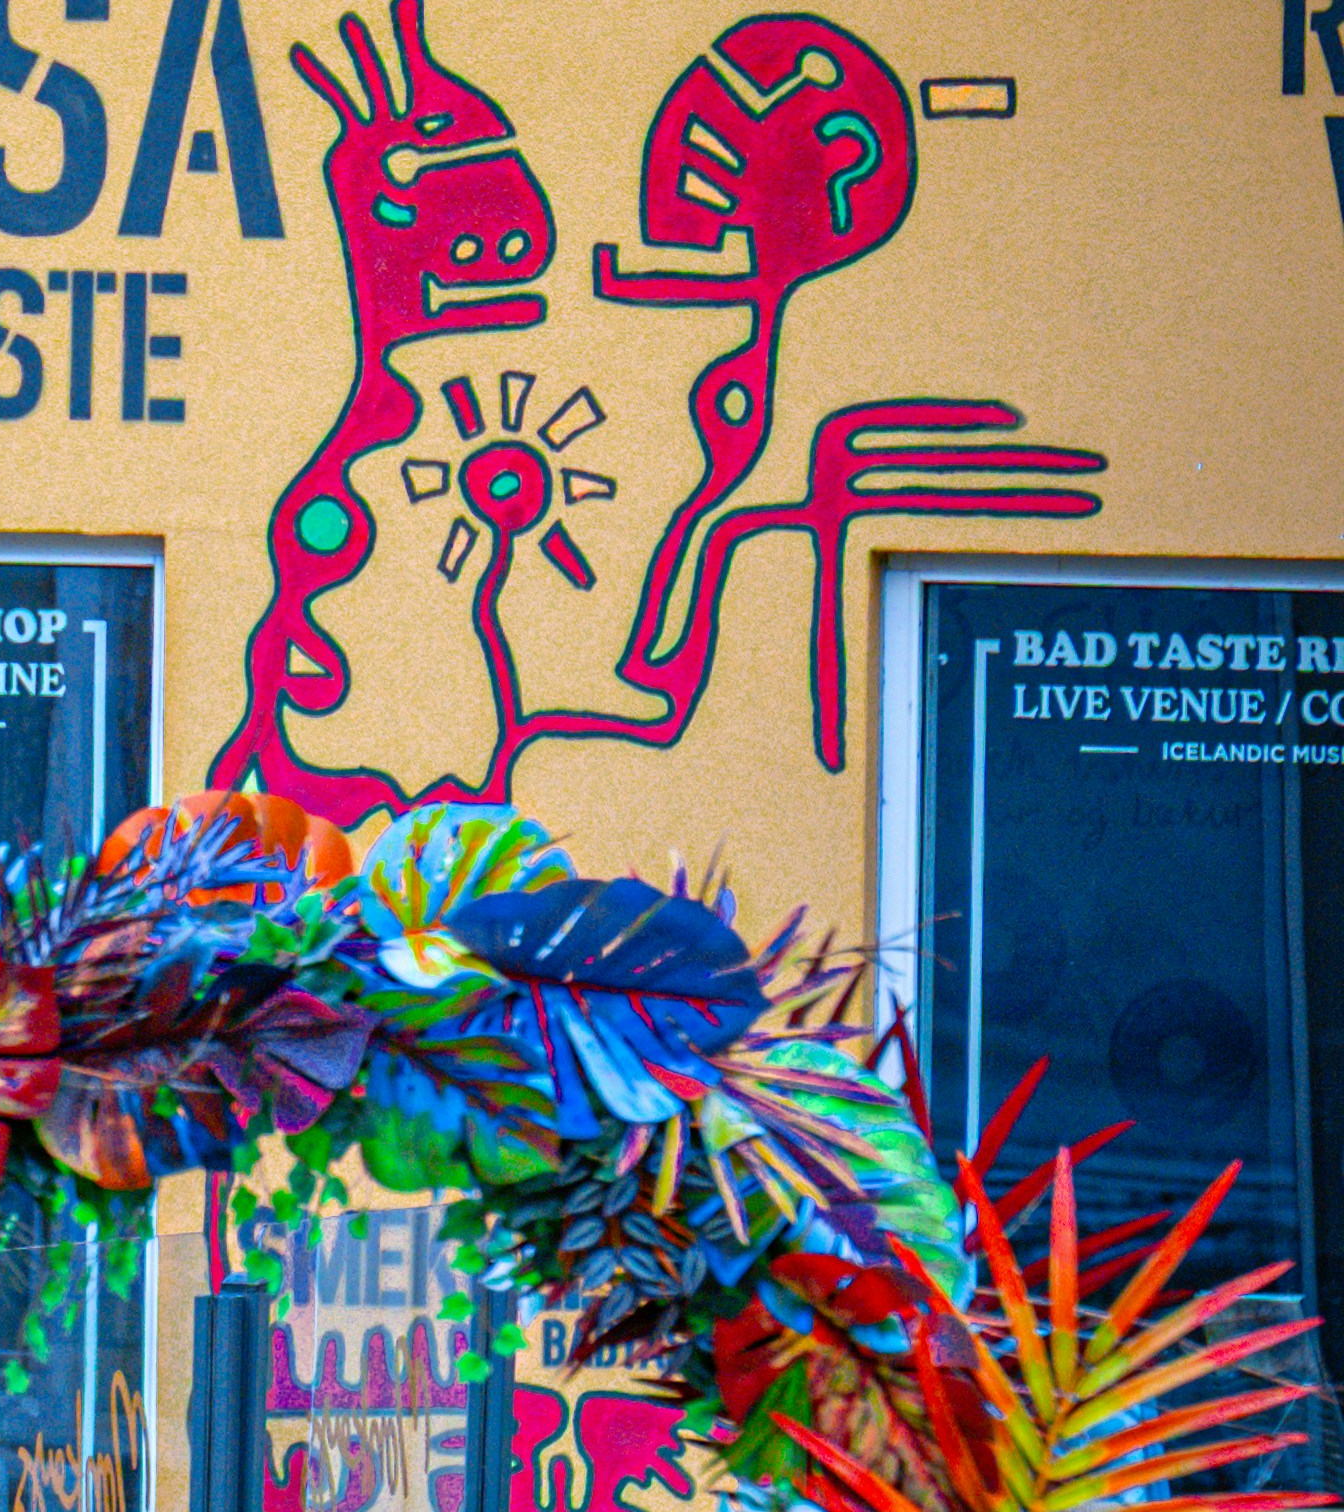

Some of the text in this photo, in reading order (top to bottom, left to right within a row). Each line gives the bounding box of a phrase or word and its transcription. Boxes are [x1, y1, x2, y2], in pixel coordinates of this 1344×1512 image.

[1013, 630, 1118, 668] BAD
[1127, 632, 1287, 672] TASTE
[1013, 684, 1112, 721] LIVE
[1119, 687, 1267, 724] VENUE
[1274, 690, 1293, 726] /
[1161, 741, 1286, 764] ICELANDIC
